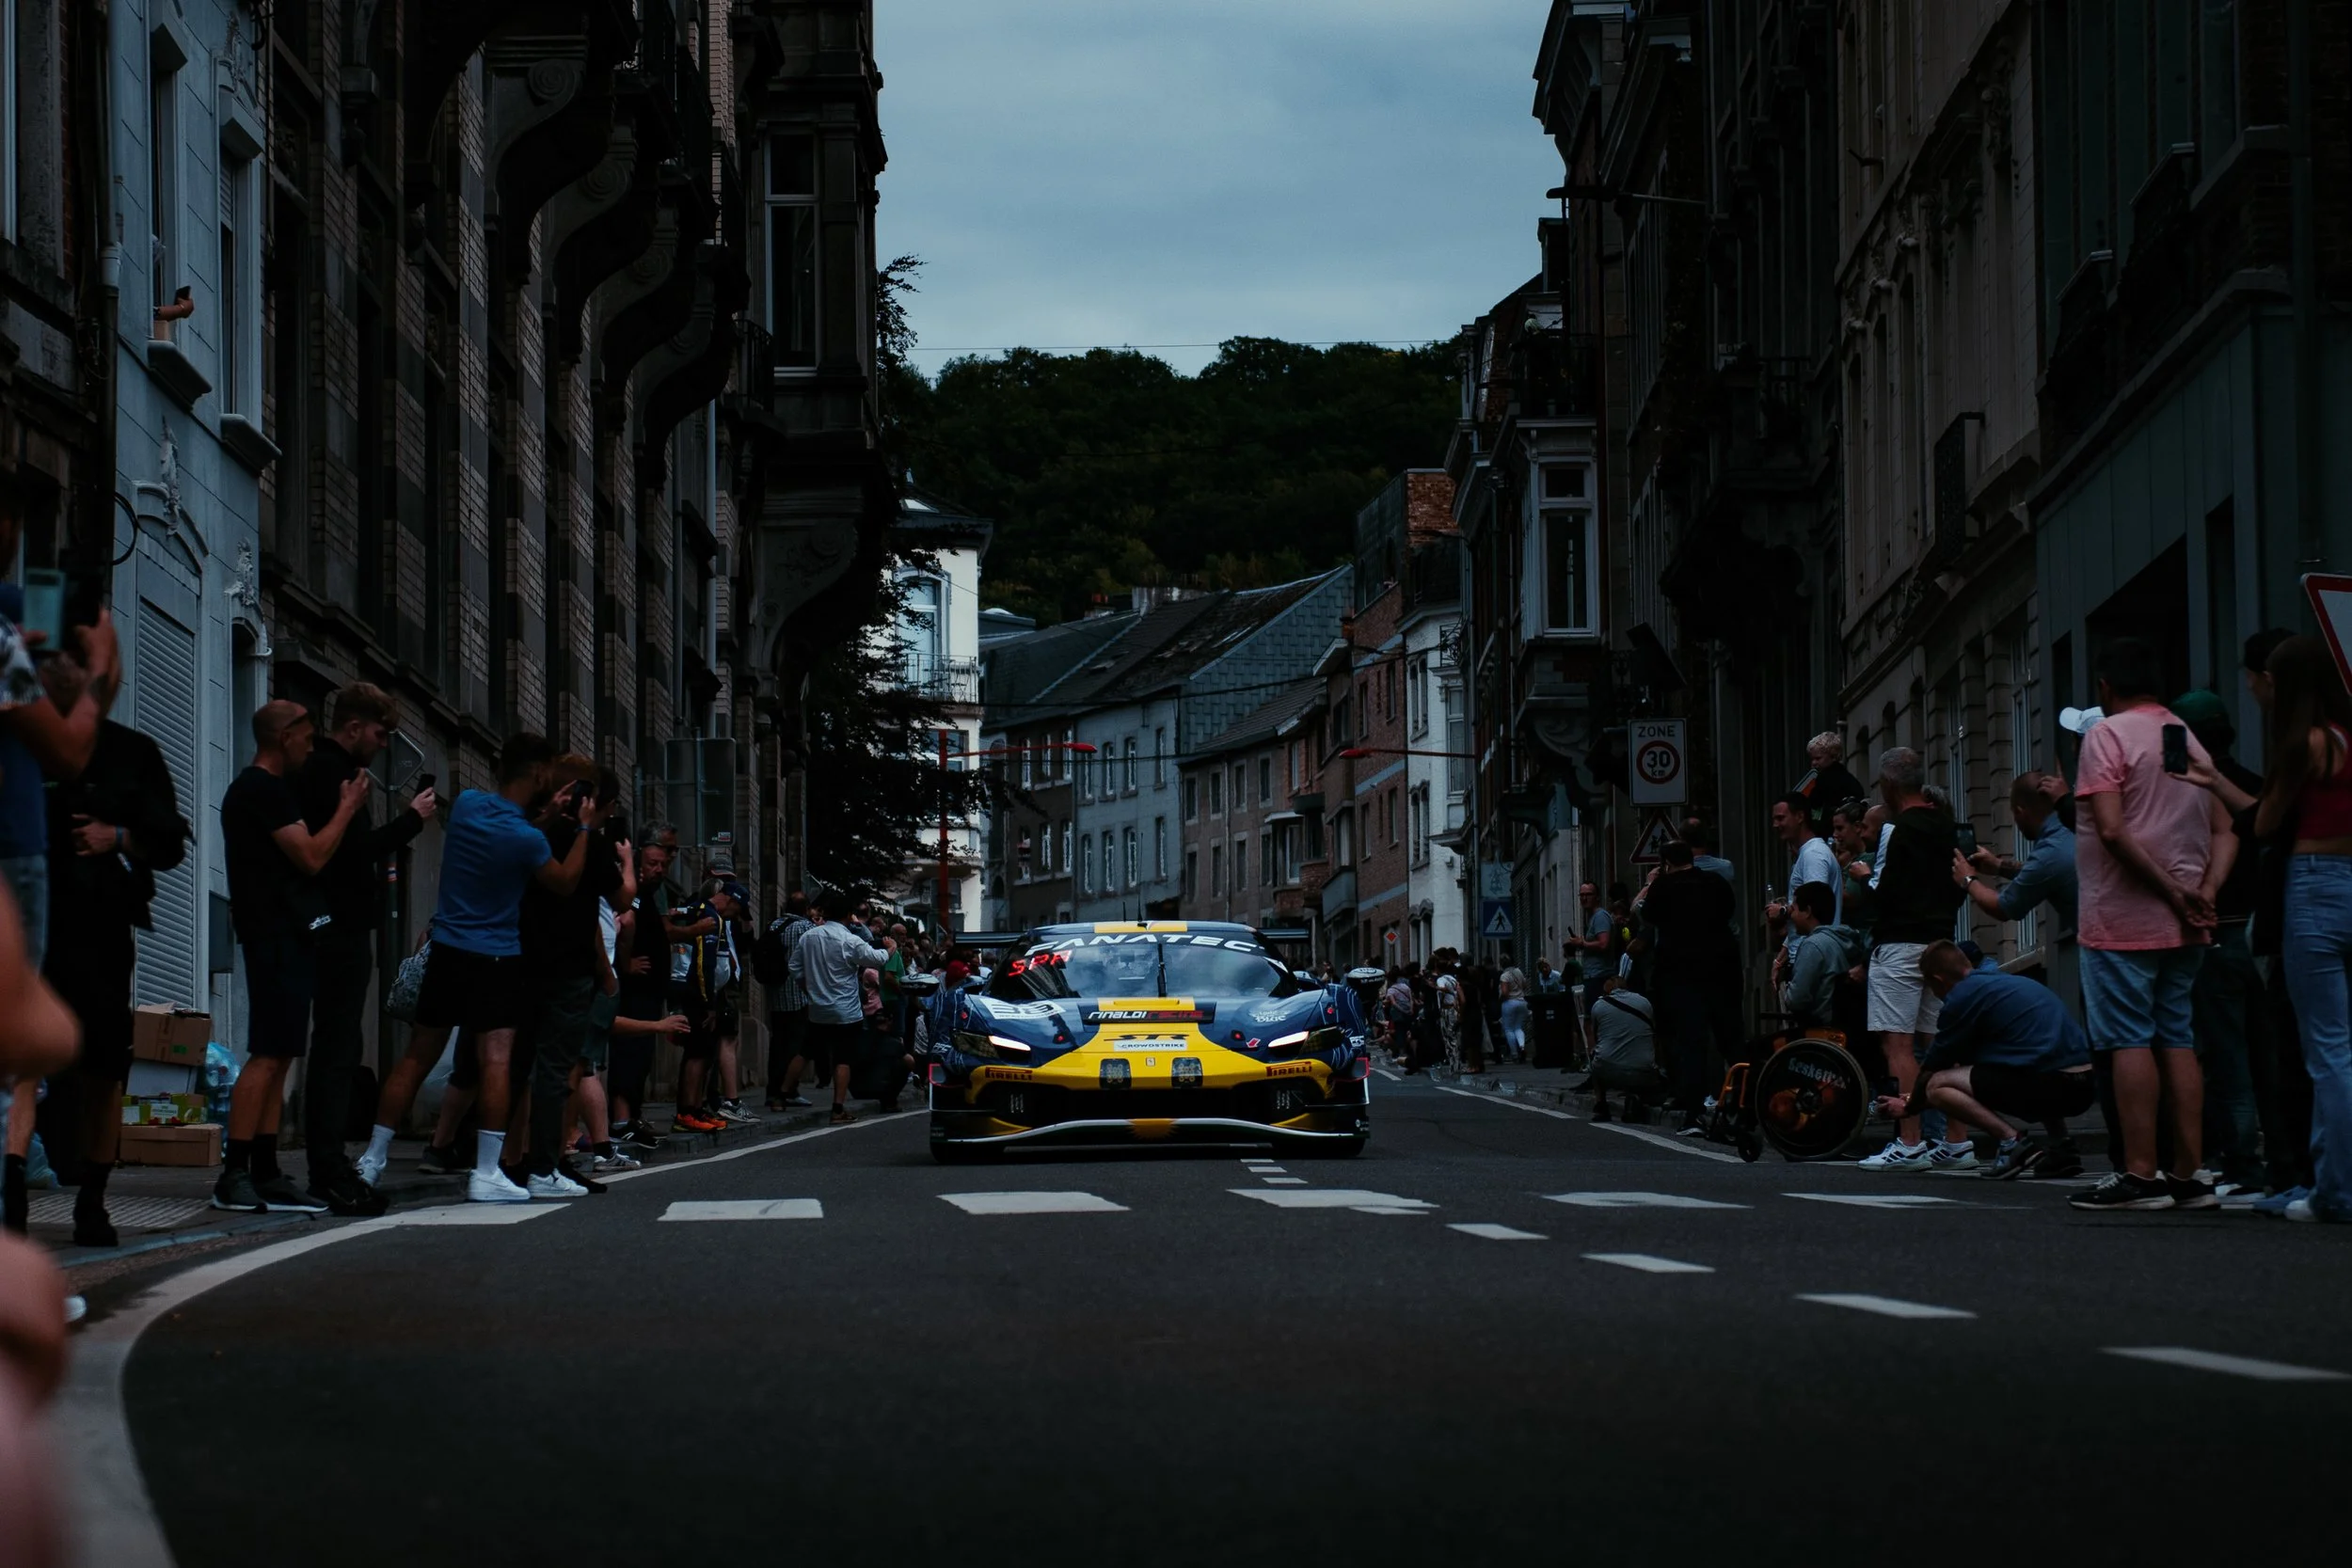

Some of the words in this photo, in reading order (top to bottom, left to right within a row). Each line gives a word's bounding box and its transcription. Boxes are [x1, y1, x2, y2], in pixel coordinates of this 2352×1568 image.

[1637, 725, 1676, 737] ZONE
[1646, 751, 1671, 767] 30
[1651, 767, 1665, 777] km
[1024, 933, 1258, 957] FANATEC
[985, 1067, 1033, 1081] PIRELLI
[1266, 1061, 1312, 1077] PIRELLI
